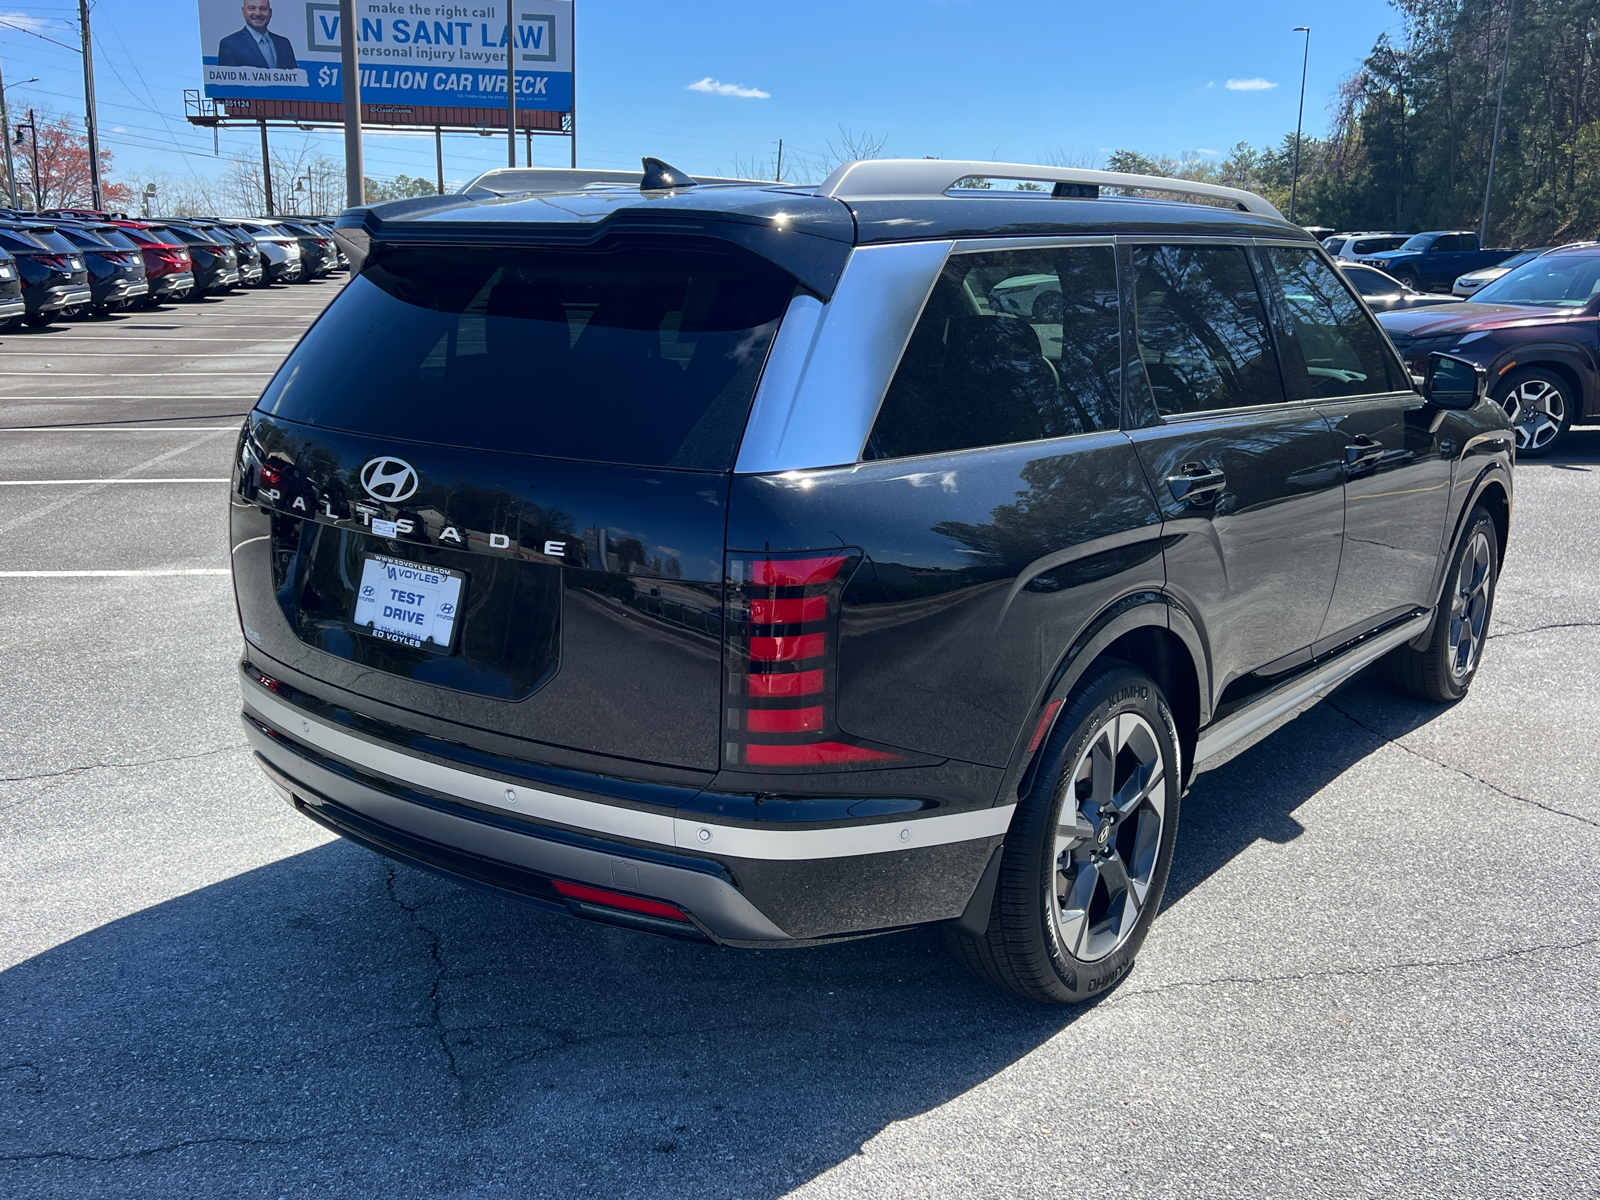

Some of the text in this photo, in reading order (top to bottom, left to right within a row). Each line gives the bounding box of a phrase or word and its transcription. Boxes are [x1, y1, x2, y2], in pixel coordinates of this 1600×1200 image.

[368, 2, 495, 19] make the right call
[319, 15, 383, 42] VN
[392, 19, 472, 46] SANT
[416, 46, 455, 62] injury
[209, 71, 298, 83] DAVID M. VAN SANT
[317, 65, 339, 88] $1
[357, 69, 428, 90] ILLION
[433, 72, 473, 92] CAR
[269, 488, 567, 557] PALISADE
[398, 568, 439, 585] VOYLES
[391, 588, 425, 606] TEST
[383, 605, 425, 626] DRIVE
[372, 629, 421, 648] ED VOYLES
[1108, 685, 1148, 709] KUMHO
[1087, 957, 1129, 992] KUMHO
